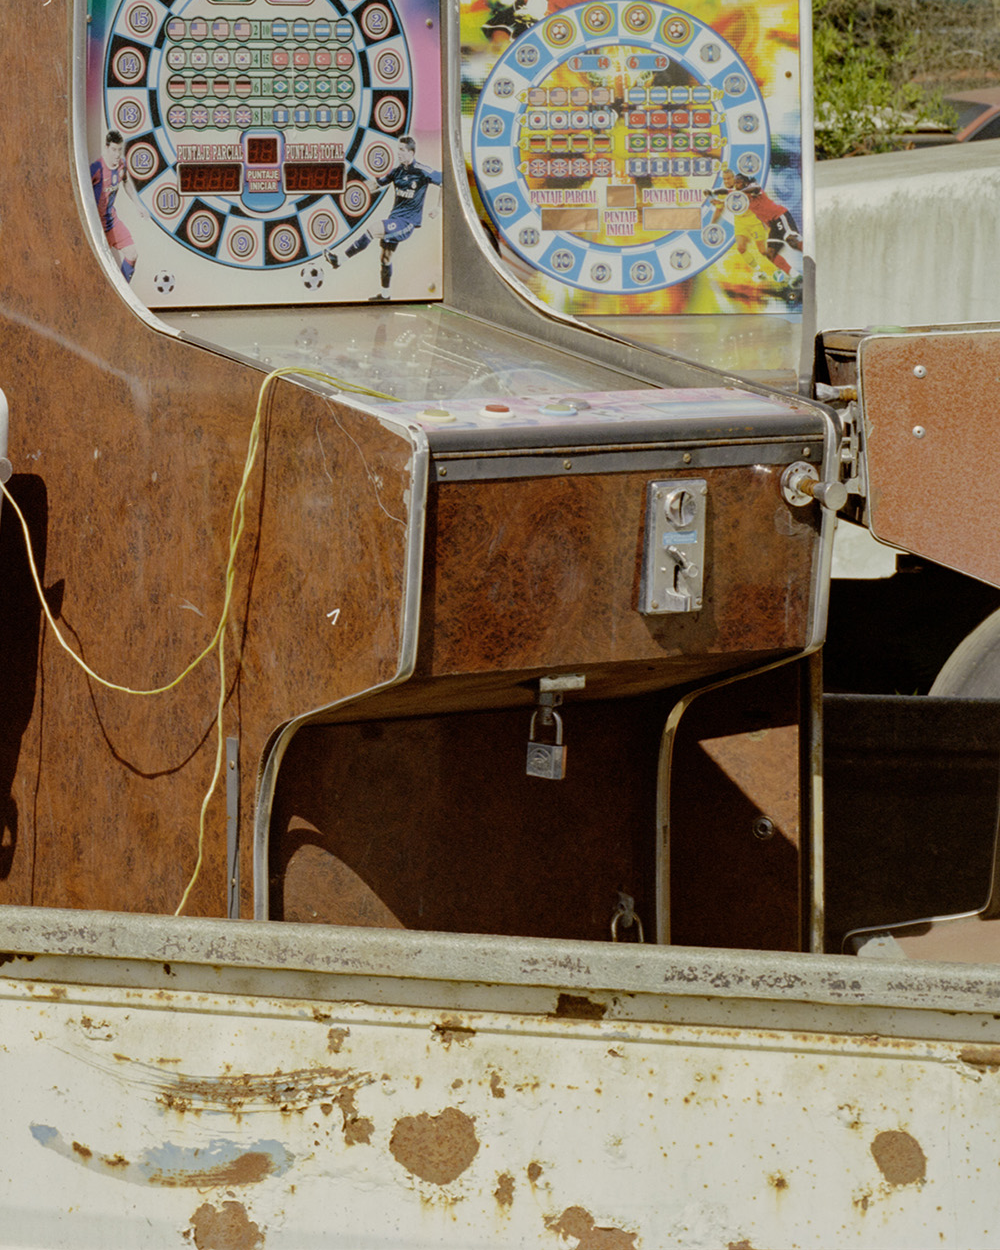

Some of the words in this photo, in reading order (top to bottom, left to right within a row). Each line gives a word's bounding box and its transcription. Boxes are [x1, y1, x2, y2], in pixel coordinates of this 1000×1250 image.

[134, 12, 149, 27] 15
[372, 13, 383, 30] 2
[253, 26, 259, 36] 2
[262, 26, 270, 35] 10
[253, 54, 259, 64] 4
[263, 54, 270, 64] 15
[706, 44, 715, 61] 1
[122, 58, 137, 73] 14
[383, 58, 395, 75] 3
[599, 58, 608, 68] 14
[629, 57, 637, 69] 6
[655, 57, 667, 68] 12
[253, 82, 259, 92] 6
[263, 82, 271, 92] 20
[497, 81, 512, 95] 15
[730, 76, 741, 93] 2
[122, 107, 138, 123] 13
[254, 111, 260, 121] 8
[384, 106, 395, 123] 4
[743, 114, 754, 133] 3
[177, 145, 210, 161] PUNTAJE
[212, 145, 244, 160] PARCIAL
[286, 145, 318, 160] PUNTAJE
[320, 145, 344, 159] TOTAL
[373, 152, 384, 167] 5
[135, 153, 150, 169] 12
[743, 155, 755, 173] 4
[247, 170, 279, 180] PUNTAJE
[250, 182, 277, 190] INICIAR
[162, 193, 176, 210] 11
[350, 191, 360, 206] 6
[530, 191, 563, 205] PUNTAJE
[565, 191, 597, 203] PARCIAL
[643, 189, 676, 203] PUNTAJE
[678, 189, 703, 202] TOTAL
[732, 195, 742, 211] 5
[498, 198, 513, 212] 12
[604, 211, 637, 223] PUNTAJE
[197, 221, 211, 237] 10
[319, 220, 329, 236] 7
[606, 224, 635, 236] INICIAL
[709, 227, 718, 244] 6
[237, 236, 248, 252] 9
[279, 235, 291, 250] 8
[523, 230, 535, 245] 11
[556, 253, 571, 268] 10
[675, 252, 685, 268] 7
[595, 264, 606, 281] 9
[636, 264, 647, 281] 8
